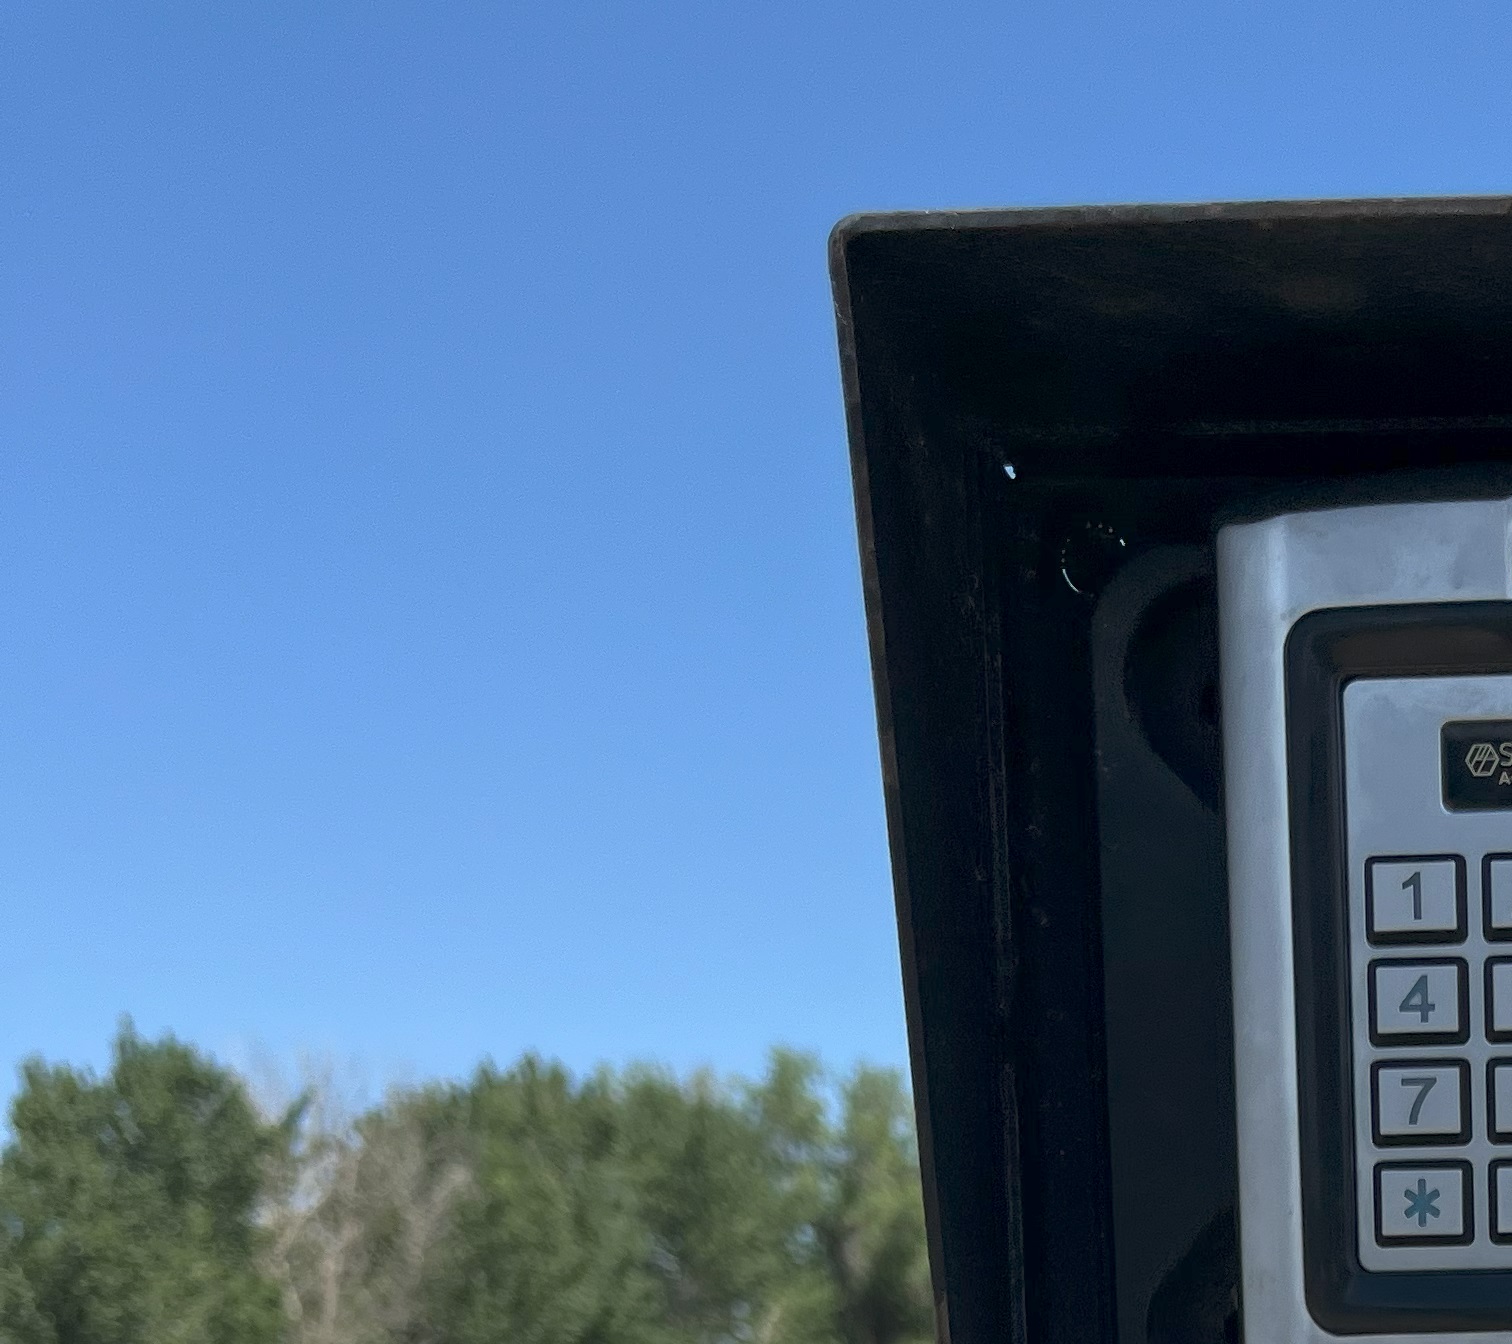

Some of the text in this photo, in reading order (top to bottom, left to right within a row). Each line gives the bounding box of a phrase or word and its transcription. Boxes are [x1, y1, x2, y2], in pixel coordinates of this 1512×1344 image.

[1401, 871, 1423, 920] 1
[1399, 975, 1436, 1024] 4
[1401, 1077, 1437, 1125] 7
